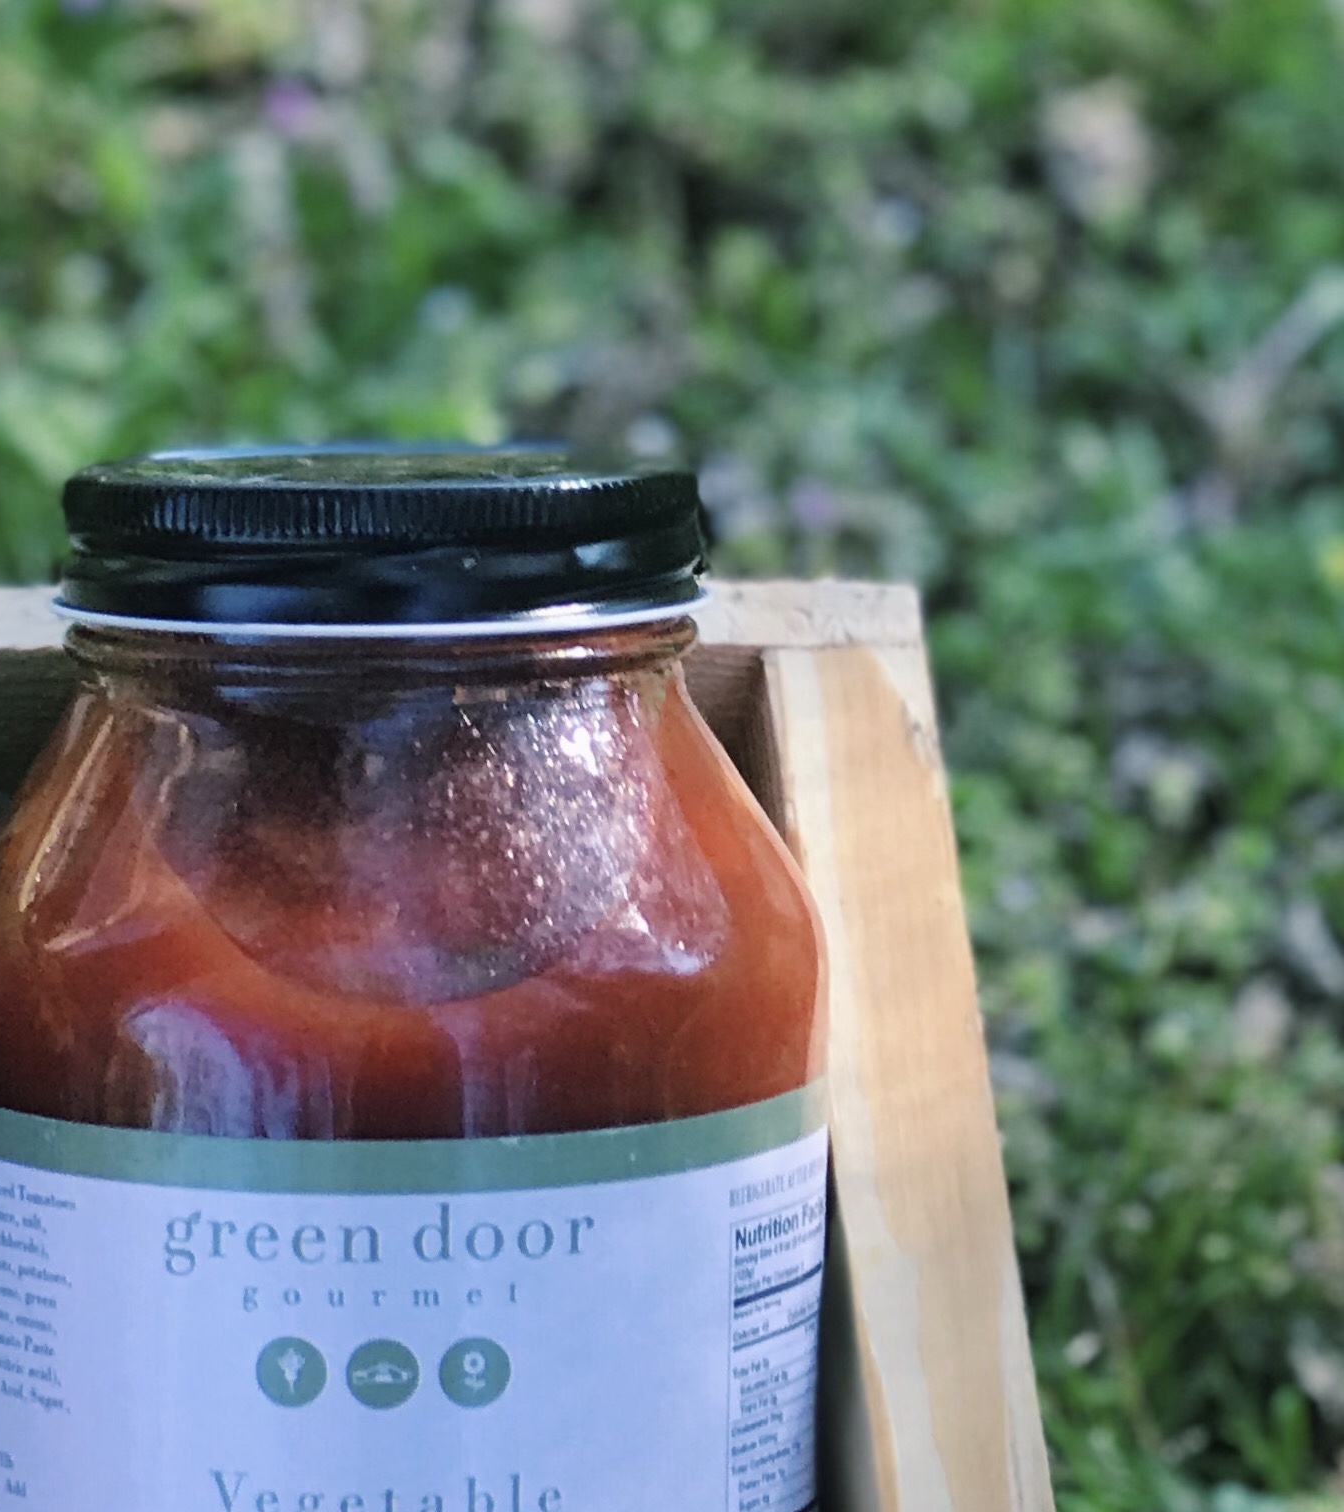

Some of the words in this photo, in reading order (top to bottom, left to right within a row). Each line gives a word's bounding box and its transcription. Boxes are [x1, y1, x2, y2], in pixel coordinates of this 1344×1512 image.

[163, 1208, 383, 1275] green
[413, 1203, 597, 1263] door
[735, 1211, 799, 1251] Nutrition
[241, 1281, 520, 1314] gourmet
